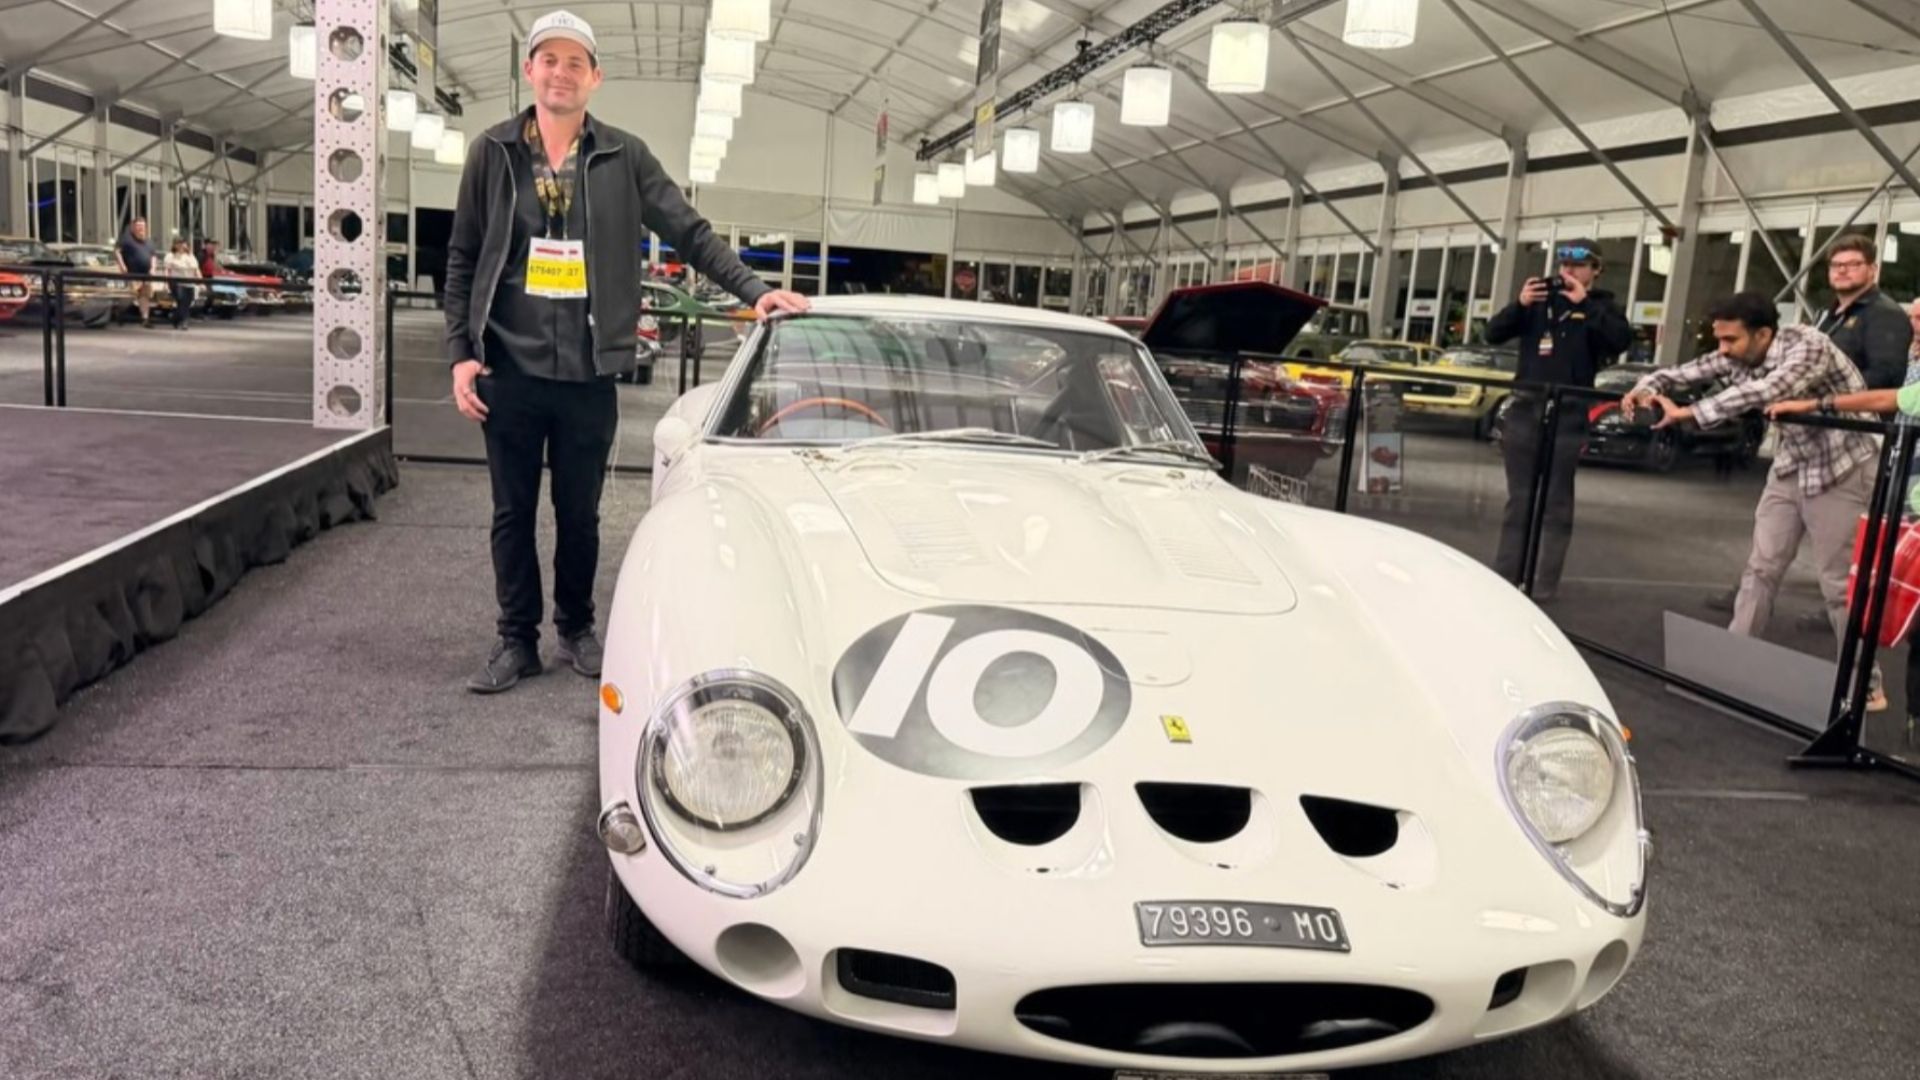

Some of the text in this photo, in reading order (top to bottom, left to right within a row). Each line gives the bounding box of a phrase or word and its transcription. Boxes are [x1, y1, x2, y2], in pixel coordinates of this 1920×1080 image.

[846, 612, 1104, 758] 10
[1147, 906, 1338, 943] 79396 MO
